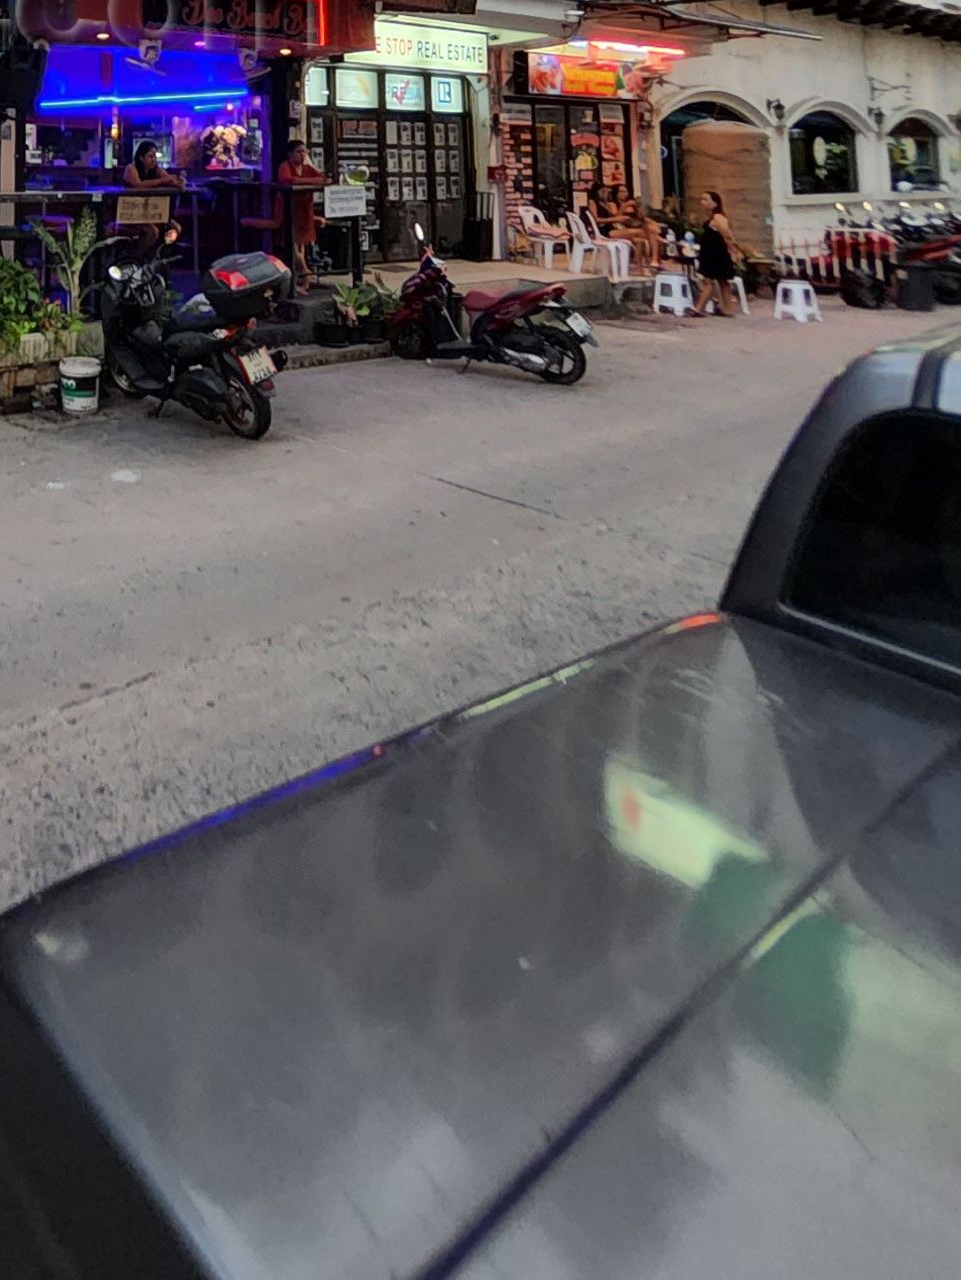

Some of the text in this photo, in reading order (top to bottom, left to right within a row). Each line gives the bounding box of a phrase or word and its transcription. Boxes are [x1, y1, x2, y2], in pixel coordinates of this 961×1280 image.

[386, 37, 414, 57] STOP
[417, 40, 444, 59] REAL
[447, 43, 484, 63] ESTATE
